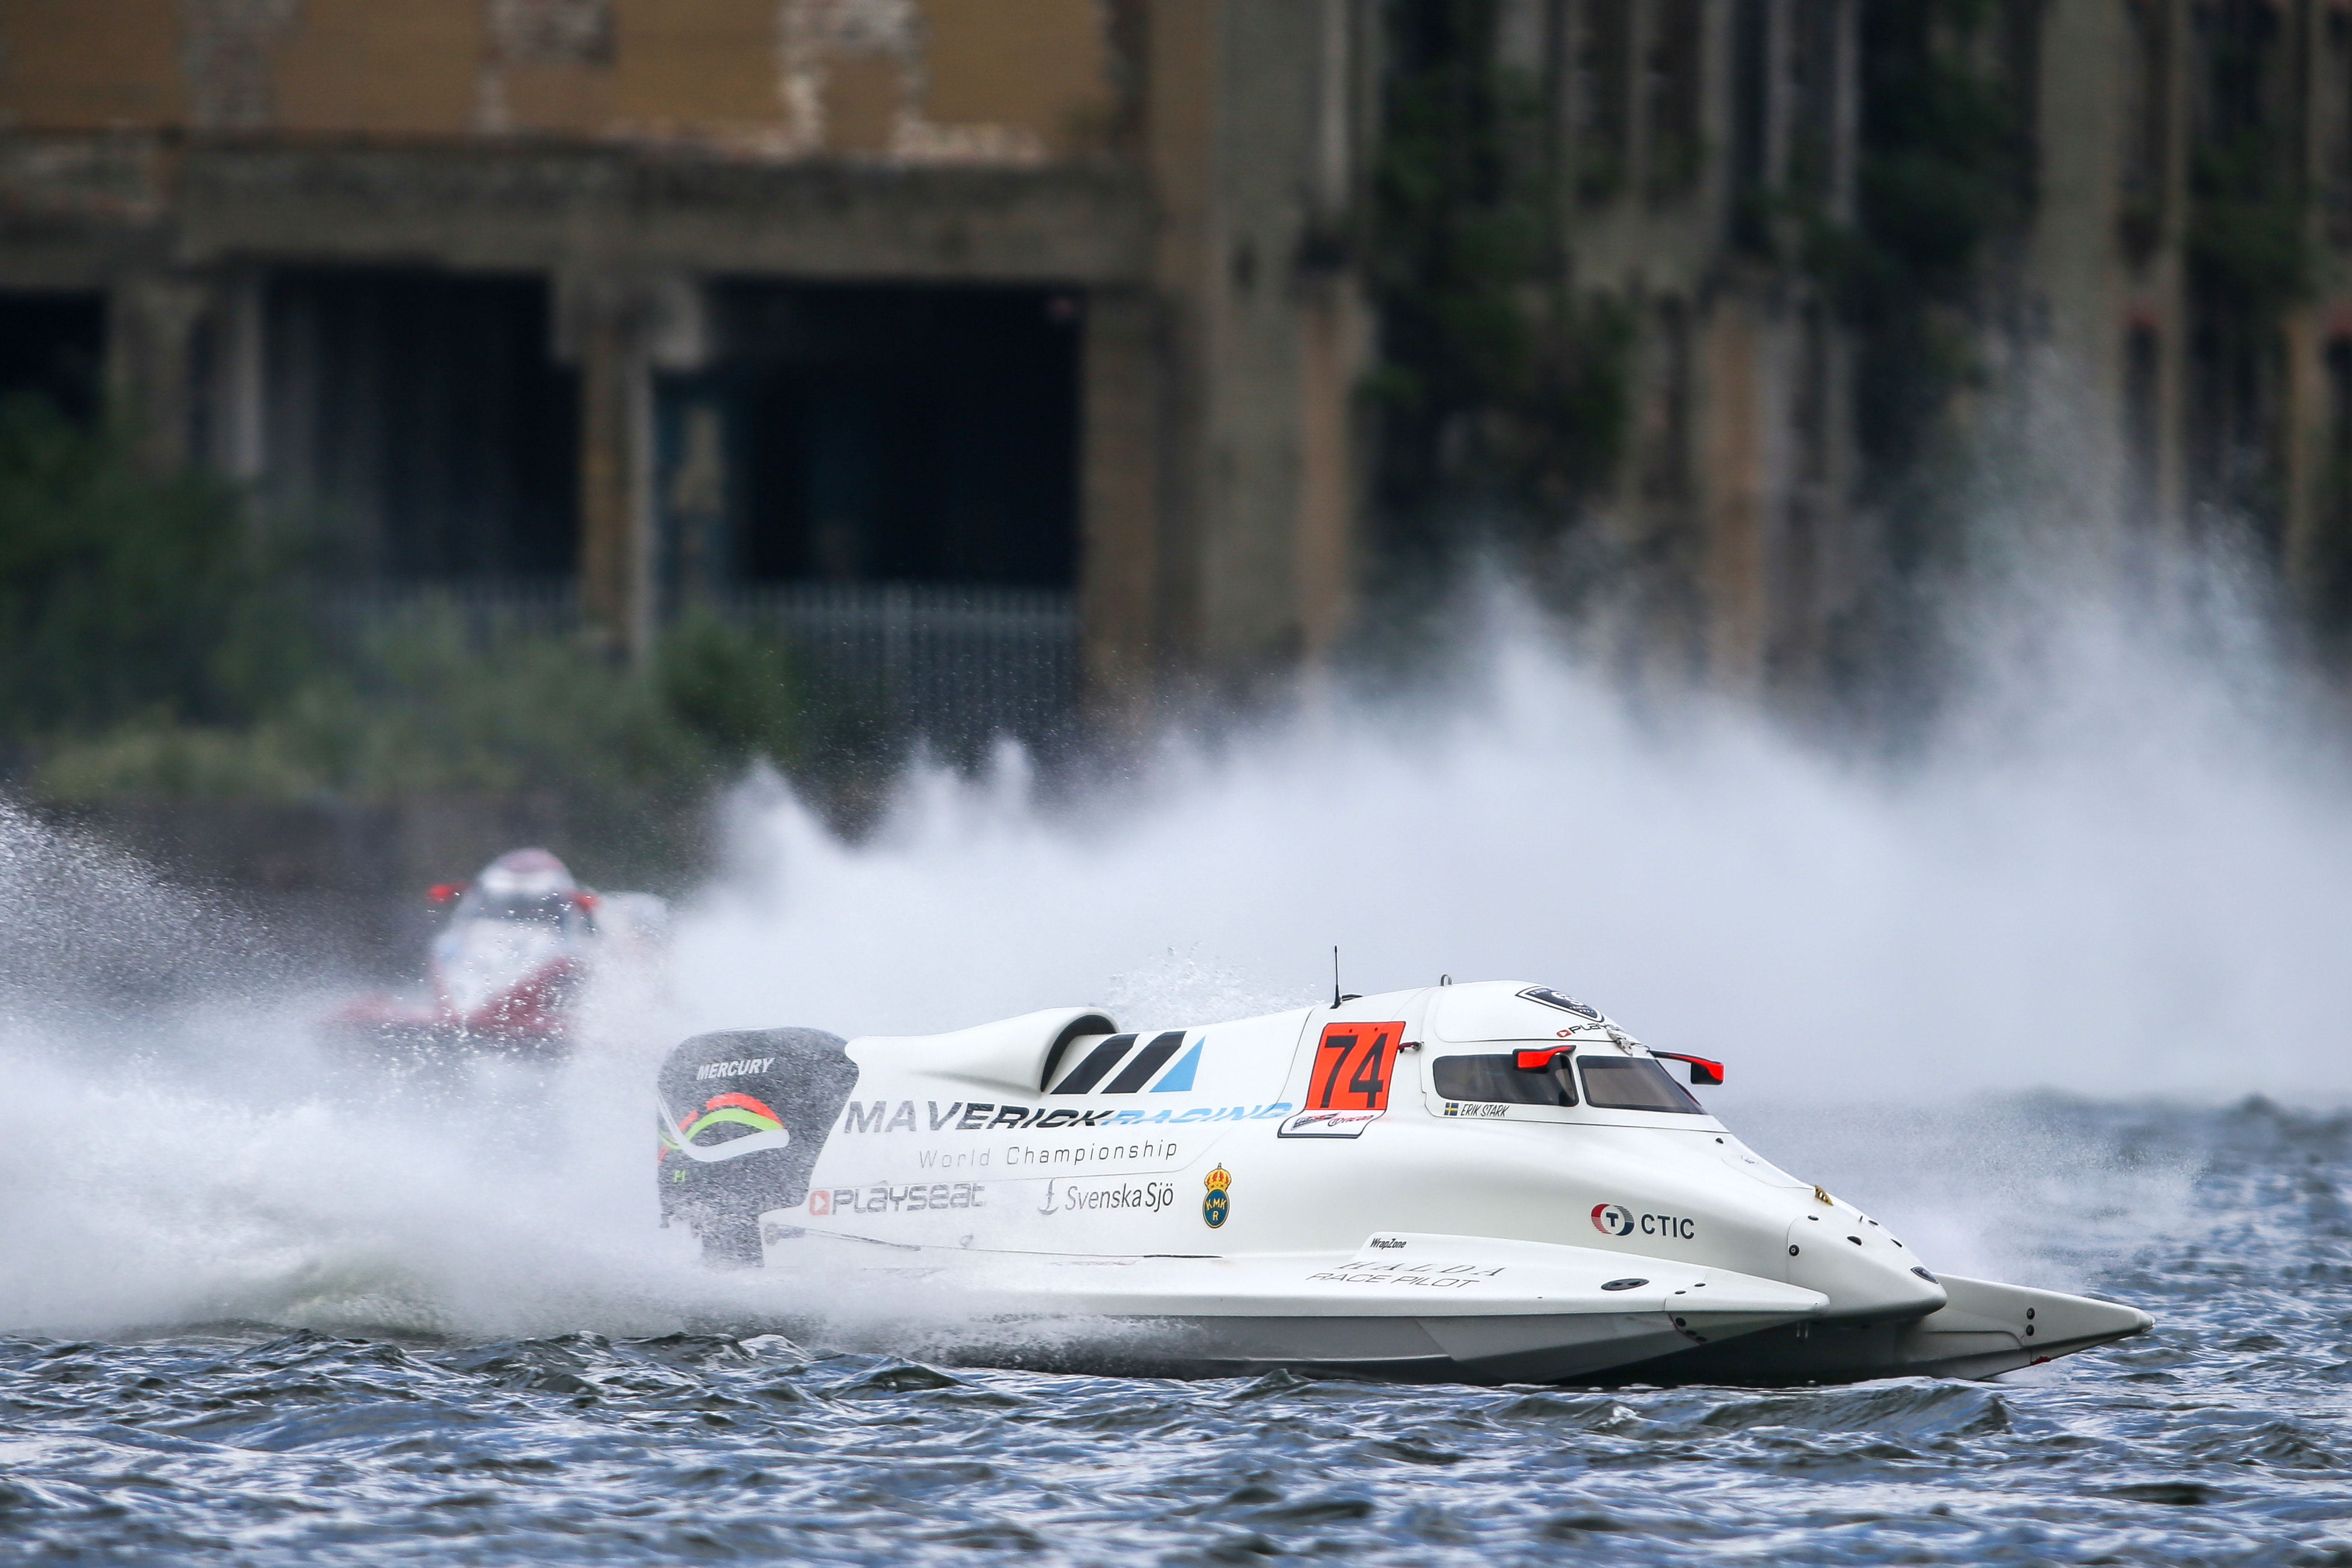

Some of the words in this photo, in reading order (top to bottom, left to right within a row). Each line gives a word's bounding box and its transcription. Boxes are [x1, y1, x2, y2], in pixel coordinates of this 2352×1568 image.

[696, 1057, 776, 1081] MERCURY
[1321, 1033, 1389, 1108] 74
[1460, 1103, 1482, 1116] ERIK
[1480, 1104, 1510, 1117] STARK
[919, 1147, 991, 1168] World
[1007, 1139, 1177, 1166] Championship
[1205, 1198, 1227, 1211] KMK
[1212, 1211, 1219, 1221] R
[1640, 1213, 1695, 1240] CTIC
[1370, 1237, 1407, 1249] WrapZone
[1334, 1261, 1507, 1277] HALDA
[1305, 1273, 1392, 1283] RACE
[1390, 1276, 1480, 1288] PILOT
